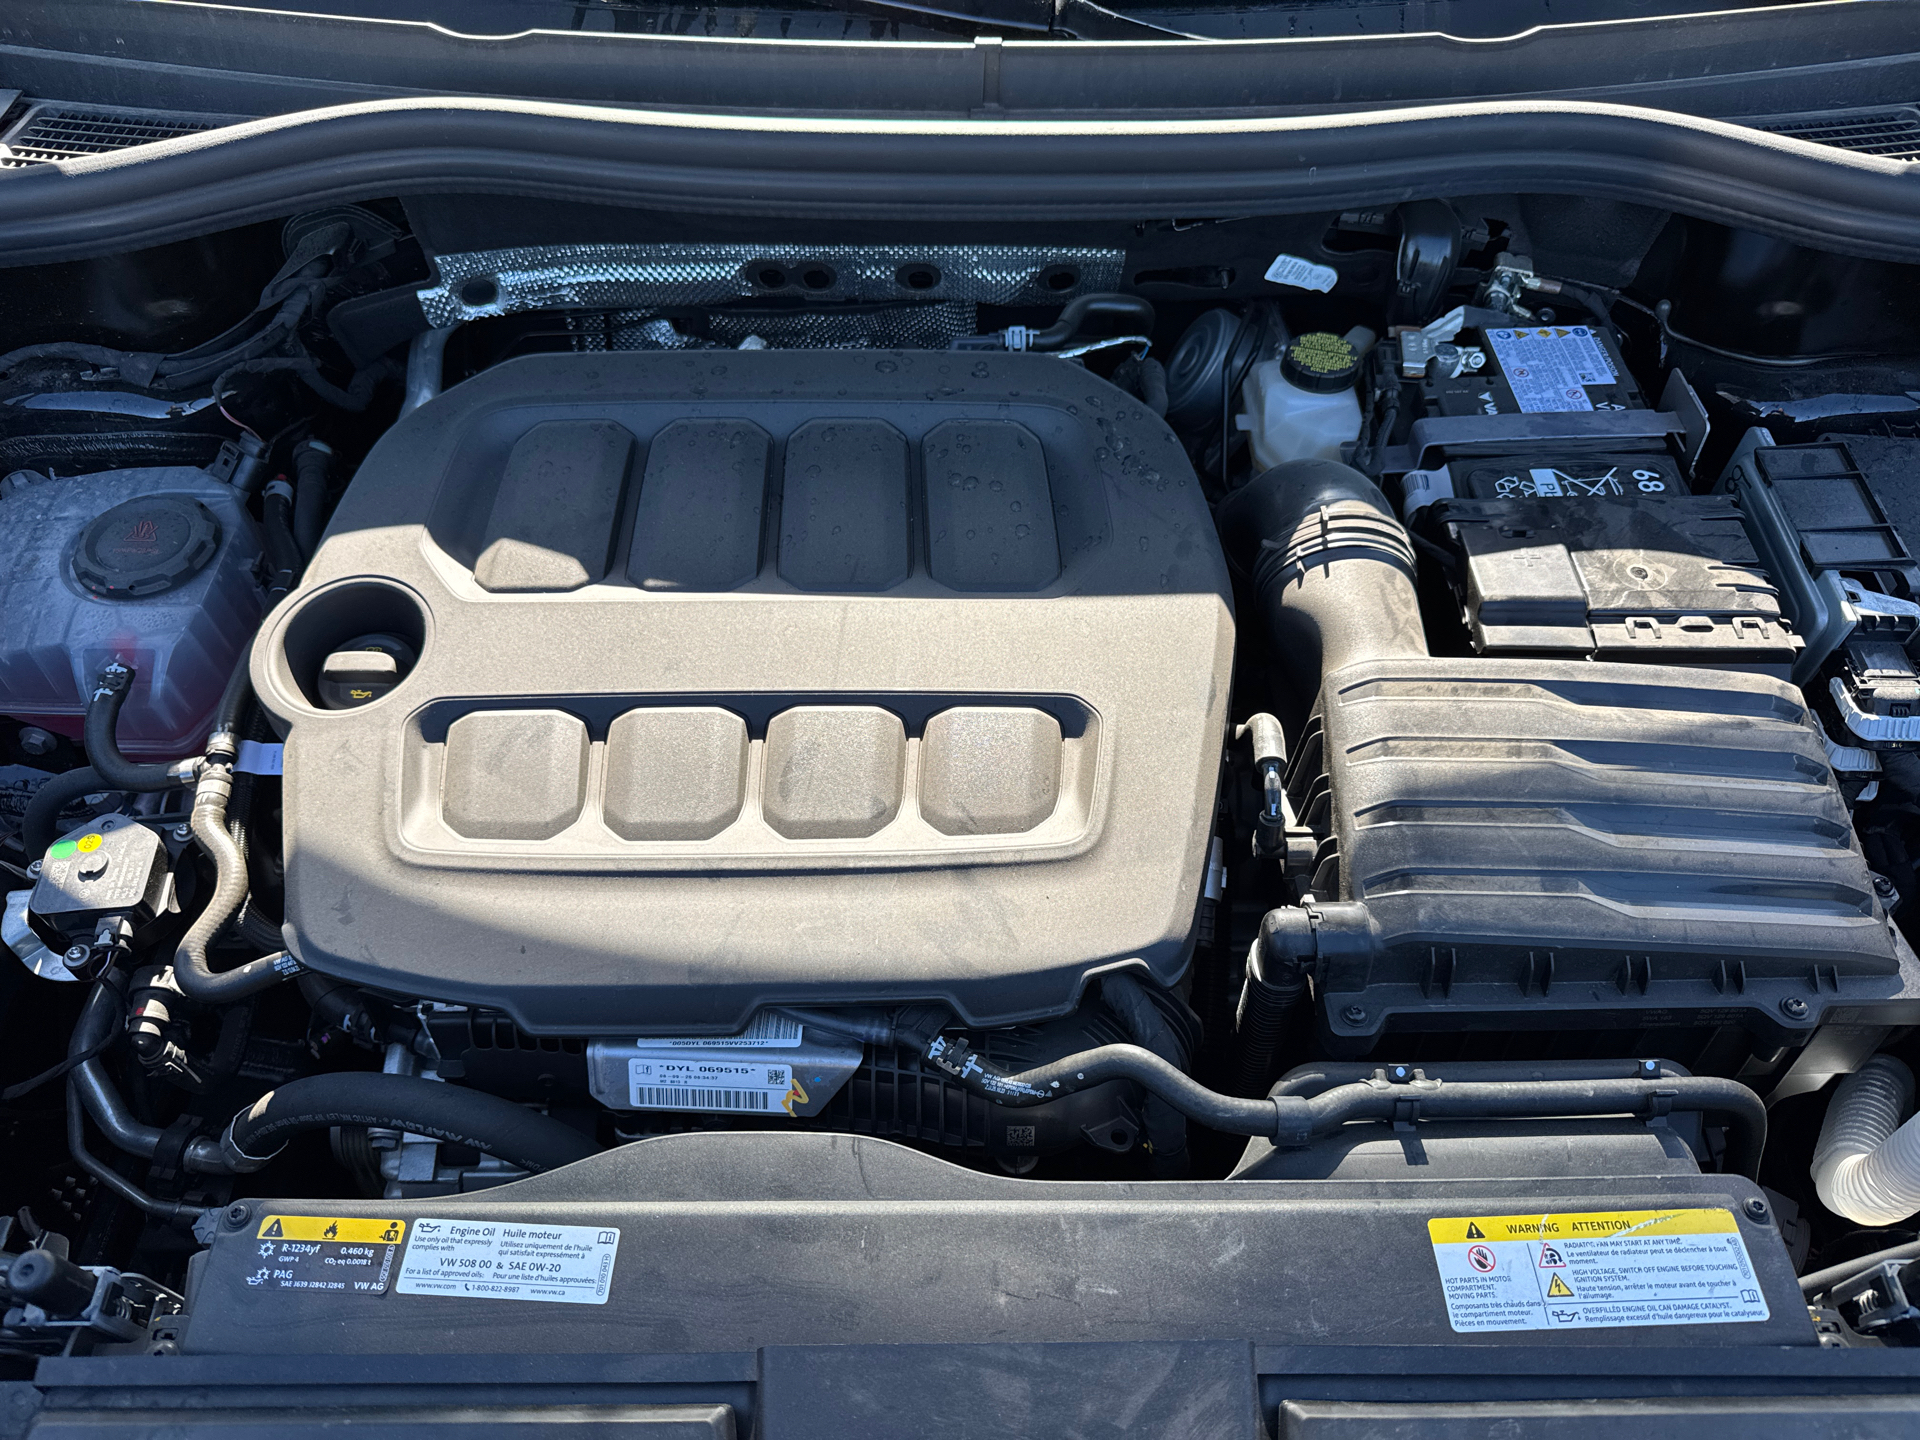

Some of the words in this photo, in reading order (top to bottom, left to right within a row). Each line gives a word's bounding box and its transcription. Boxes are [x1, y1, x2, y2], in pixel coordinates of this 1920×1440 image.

[1506, 1223, 1560, 1234] WARNING
[1572, 1220, 1631, 1232] ATTENTION
[450, 1226, 480, 1238] Engine
[482, 1228, 496, 1237] Oil
[503, 1229, 525, 1239] Huile
[528, 1231, 562, 1240] moteur
[428, 1236, 440, 1244] only
[463, 1239, 493, 1247] expressly
[500, 1241, 523, 1249] Utilisez
[525, 1243, 560, 1252] uniquement
[282, 1244, 321, 1255] R-1234yf
[341, 1247, 363, 1255] 0.460
[364, 1248, 374, 1257] kg
[412, 1244, 438, 1252] complies
[440, 1244, 455, 1252] with
[1650, 1248, 1664, 1256] peut
[1674, 1246, 1707, 1254] déclencher
[498, 1249, 508, 1257] qui
[510, 1249, 534, 1257] satisfait
[536, 1250, 578, 1259] expressément
[440, 1258, 457, 1267] VW
[458, 1258, 476, 1268] 508
[478, 1260, 492, 1269] 00
[496, 1262, 504, 1270] &
[508, 1261, 527, 1271] SAE
[529, 1263, 561, 1273] 0W-20
[273, 1270, 293, 1279] PAG
[422, 1268, 431, 1276] list
[433, 1268, 439, 1276] of
[441, 1269, 468, 1279] approved
[470, 1270, 484, 1278] oils:
[493, 1272, 505, 1280] Pour
[520, 1273, 533, 1281] liste
[535, 1274, 558, 1283] d'huiles
[559, 1276, 597, 1285] approuvées:
[1589, 1268, 1617, 1276] VOLTAGE,
[354, 1282, 369, 1290] VW
[370, 1283, 384, 1291] AG
[415, 1282, 456, 1290] www.vw.com
[472, 1284, 520, 1293] 1-800-822-8987
[530, 1288, 565, 1296] www.vw.ca
[1447, 1284, 1497, 1292] COMPARTMENT.
[1578, 1292, 1614, 1300] l'allumage.
[1451, 1302, 1489, 1310] Composants
[1582, 1306, 1621, 1314] OVERFILLED
[1460, 1311, 1506, 1319] compartiment
[1585, 1315, 1625, 1323] Remplissage
[1674, 1312, 1707, 1320] dangereux
[1731, 1310, 1765, 1318] catalyseur.
[1454, 1319, 1475, 1327] Pièces
